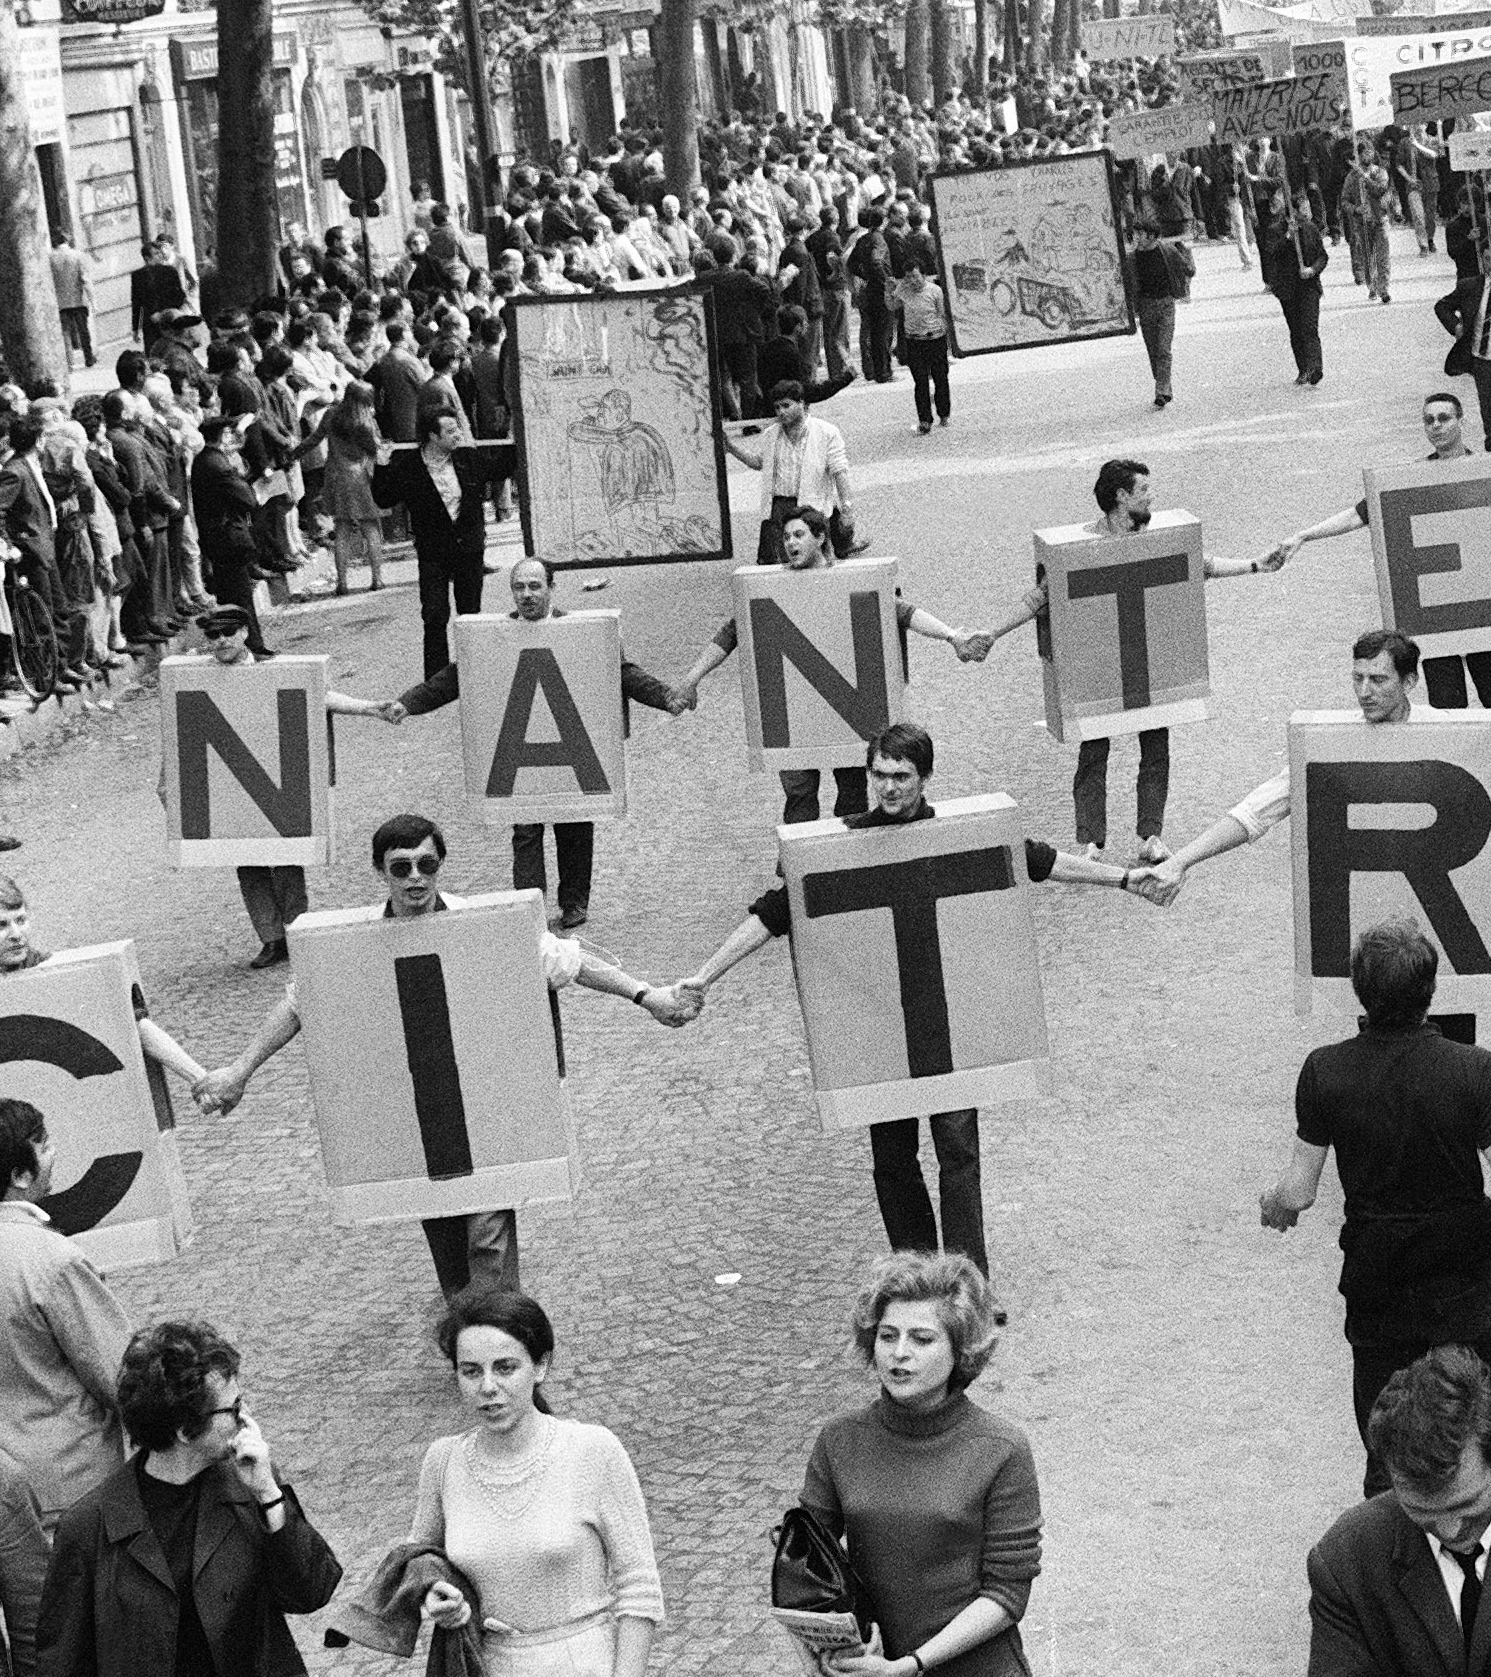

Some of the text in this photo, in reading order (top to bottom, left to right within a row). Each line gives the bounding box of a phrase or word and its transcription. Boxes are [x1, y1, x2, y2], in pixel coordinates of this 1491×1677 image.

[1297, 53, 1344, 71] 1000
[178, 691, 310, 837] N
[487, 651, 607, 795] A
[752, 593, 890, 749] N
[1068, 554, 1188, 708] T
[803, 847, 1014, 1077] T
